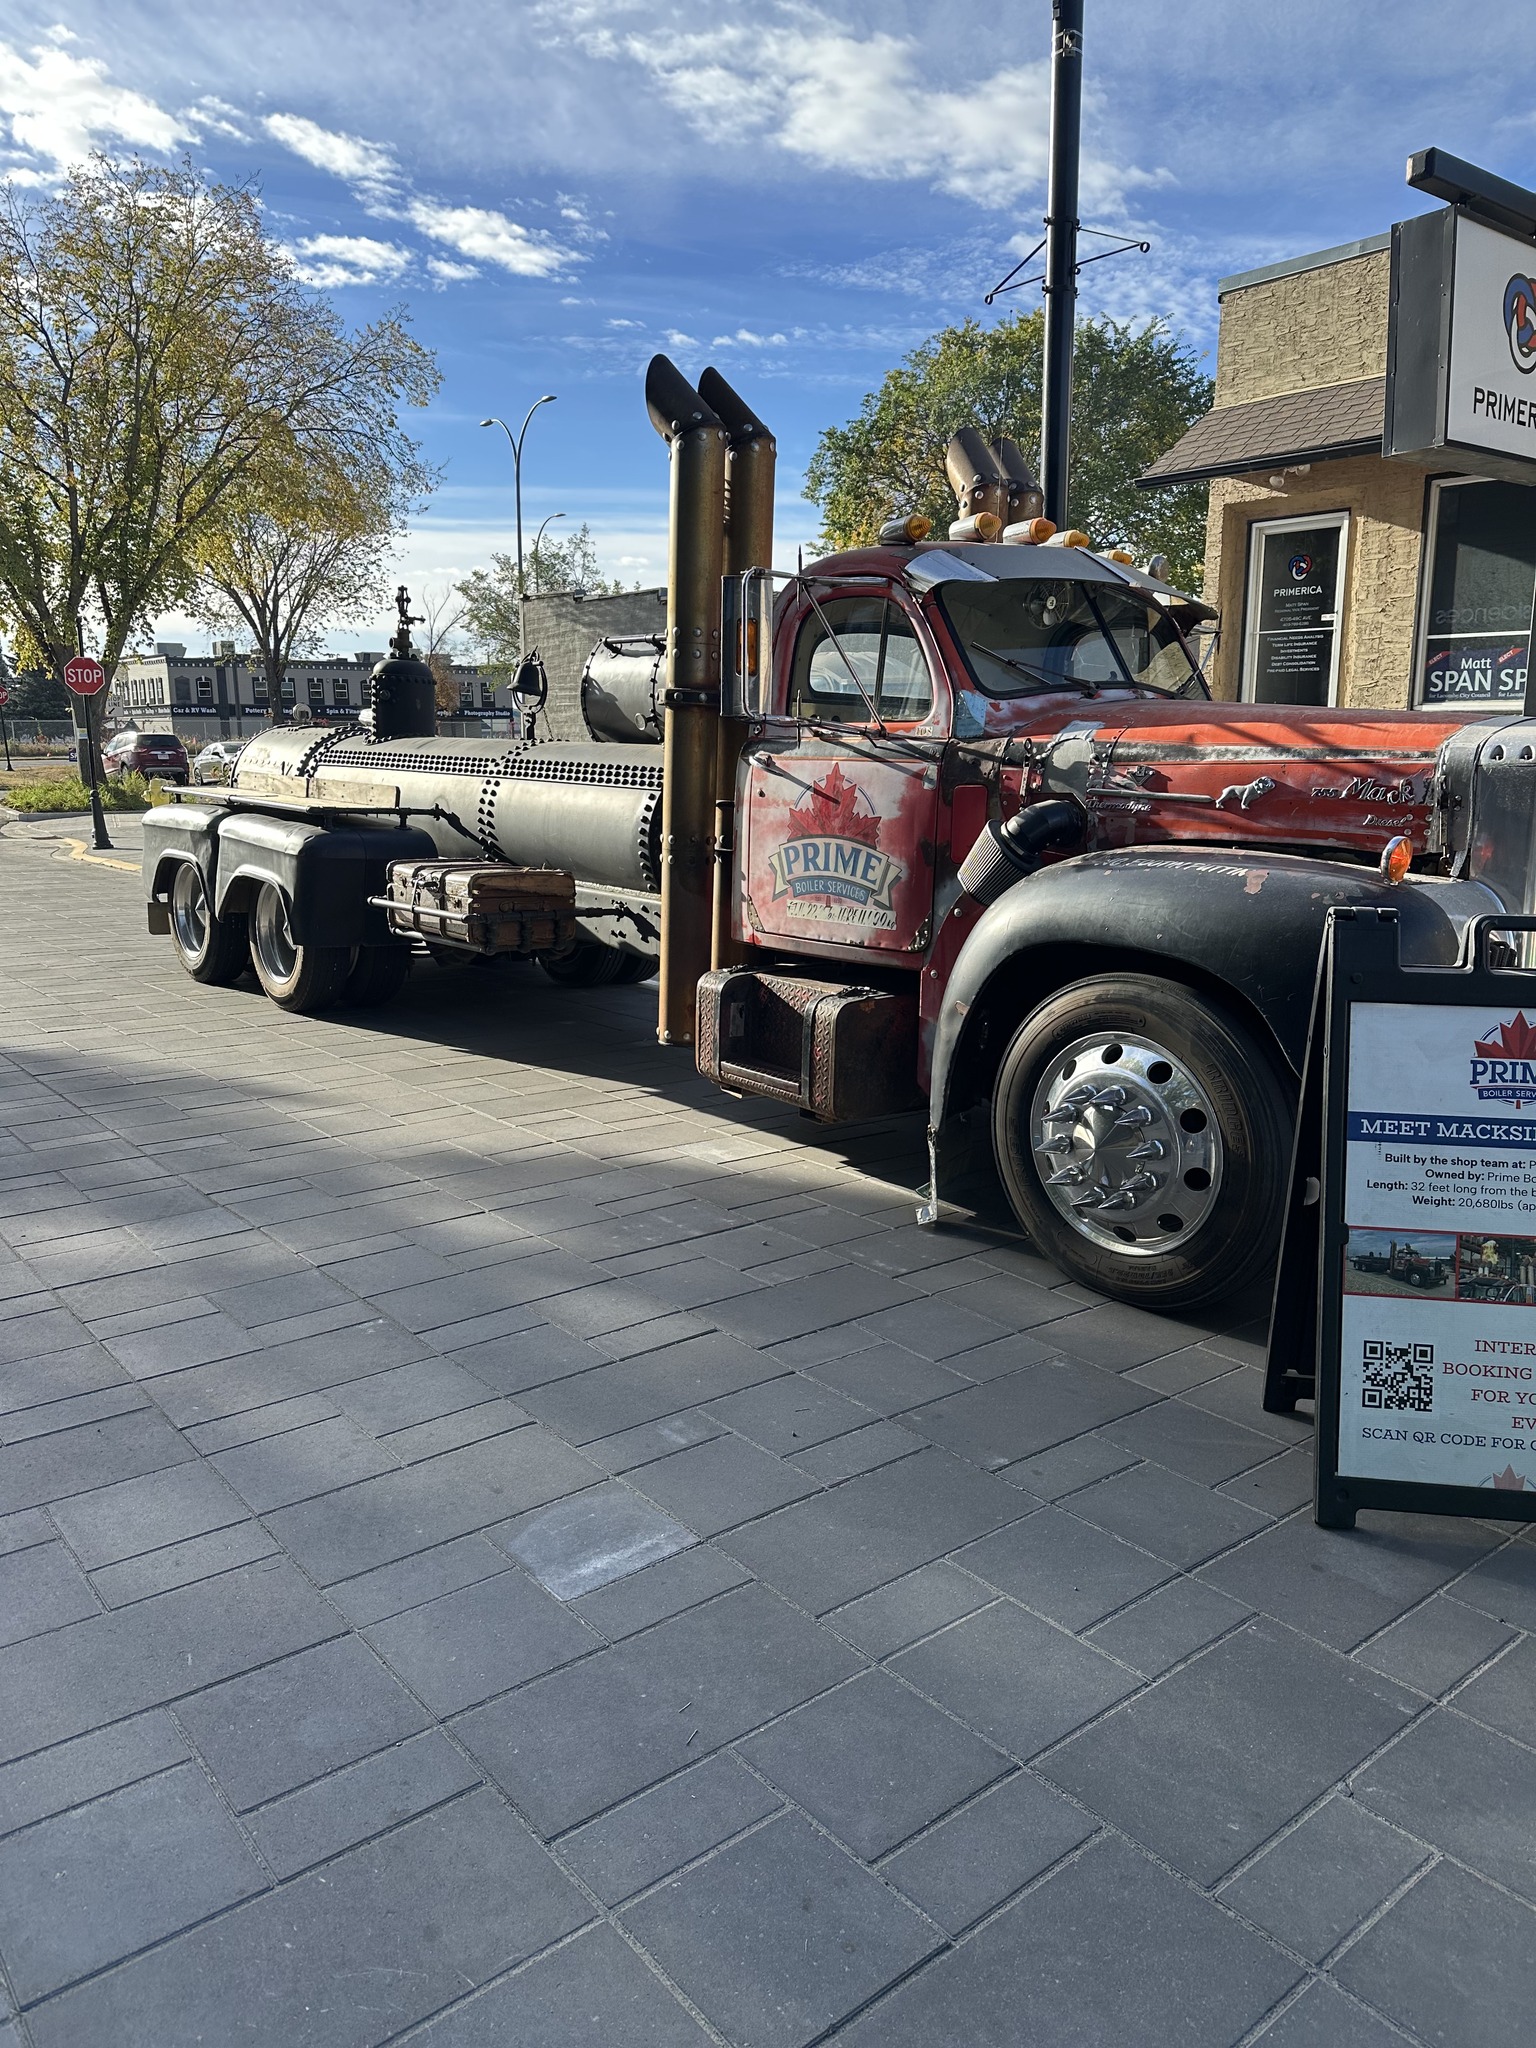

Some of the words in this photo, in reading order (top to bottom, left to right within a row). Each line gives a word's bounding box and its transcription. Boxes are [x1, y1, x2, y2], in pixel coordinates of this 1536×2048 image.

[1473, 386, 1536, 430] PRIMER
[1273, 585, 1323, 598] PRIMERICA
[1429, 653, 1443, 665] ELECT
[1461, 658, 1492, 669] Matt
[1498, 650, 1514, 663] ELECT
[67, 668, 102, 684] STOP
[1430, 670, 1492, 692] SPAN
[326, 708, 339, 716] Spin
[1339, 777, 1415, 804] Mack
[1362, 814, 1407, 827] Diesel
[783, 841, 883, 886] PRIME
[795, 880, 824, 894] BOILER
[827, 880, 866, 901] SERVICES
[1483, 1089, 1513, 1098] BOILER
[1361, 1118, 1431, 1136] MEET
[1437, 1122, 1536, 1142] MACKSI
[1385, 1153, 1411, 1164] Built
[1414, 1154, 1427, 1166] by
[1430, 1155, 1448, 1165] the
[1451, 1156, 1478, 1169] shop
[1481, 1158, 1509, 1168] team
[1511, 1160, 1526, 1169] at:
[1425, 1169, 1465, 1180] Owned
[1468, 1170, 1485, 1182] by:
[1488, 1171, 1520, 1183] Prime
[1367, 1179, 1408, 1192] Length:
[1411, 1181, 1425, 1191] 32
[1428, 1182, 1450, 1193] feet
[1453, 1183, 1477, 1197] long
[1480, 1185, 1507, 1196] from
[1510, 1186, 1528, 1197] the
[1412, 1195, 1456, 1208] Weight:
[1458, 1197, 1514, 1210] 20,680lbs
[1475, 1340, 1536, 1356] INTER
[1443, 1362, 1532, 1380] BOOKING
[1471, 1388, 1511, 1404] FOR
[1362, 1427, 1408, 1442] SCAN
[1412, 1431, 1437, 1444] QR
[1440, 1433, 1486, 1448] CODE
[1491, 1437, 1526, 1451] FOR
